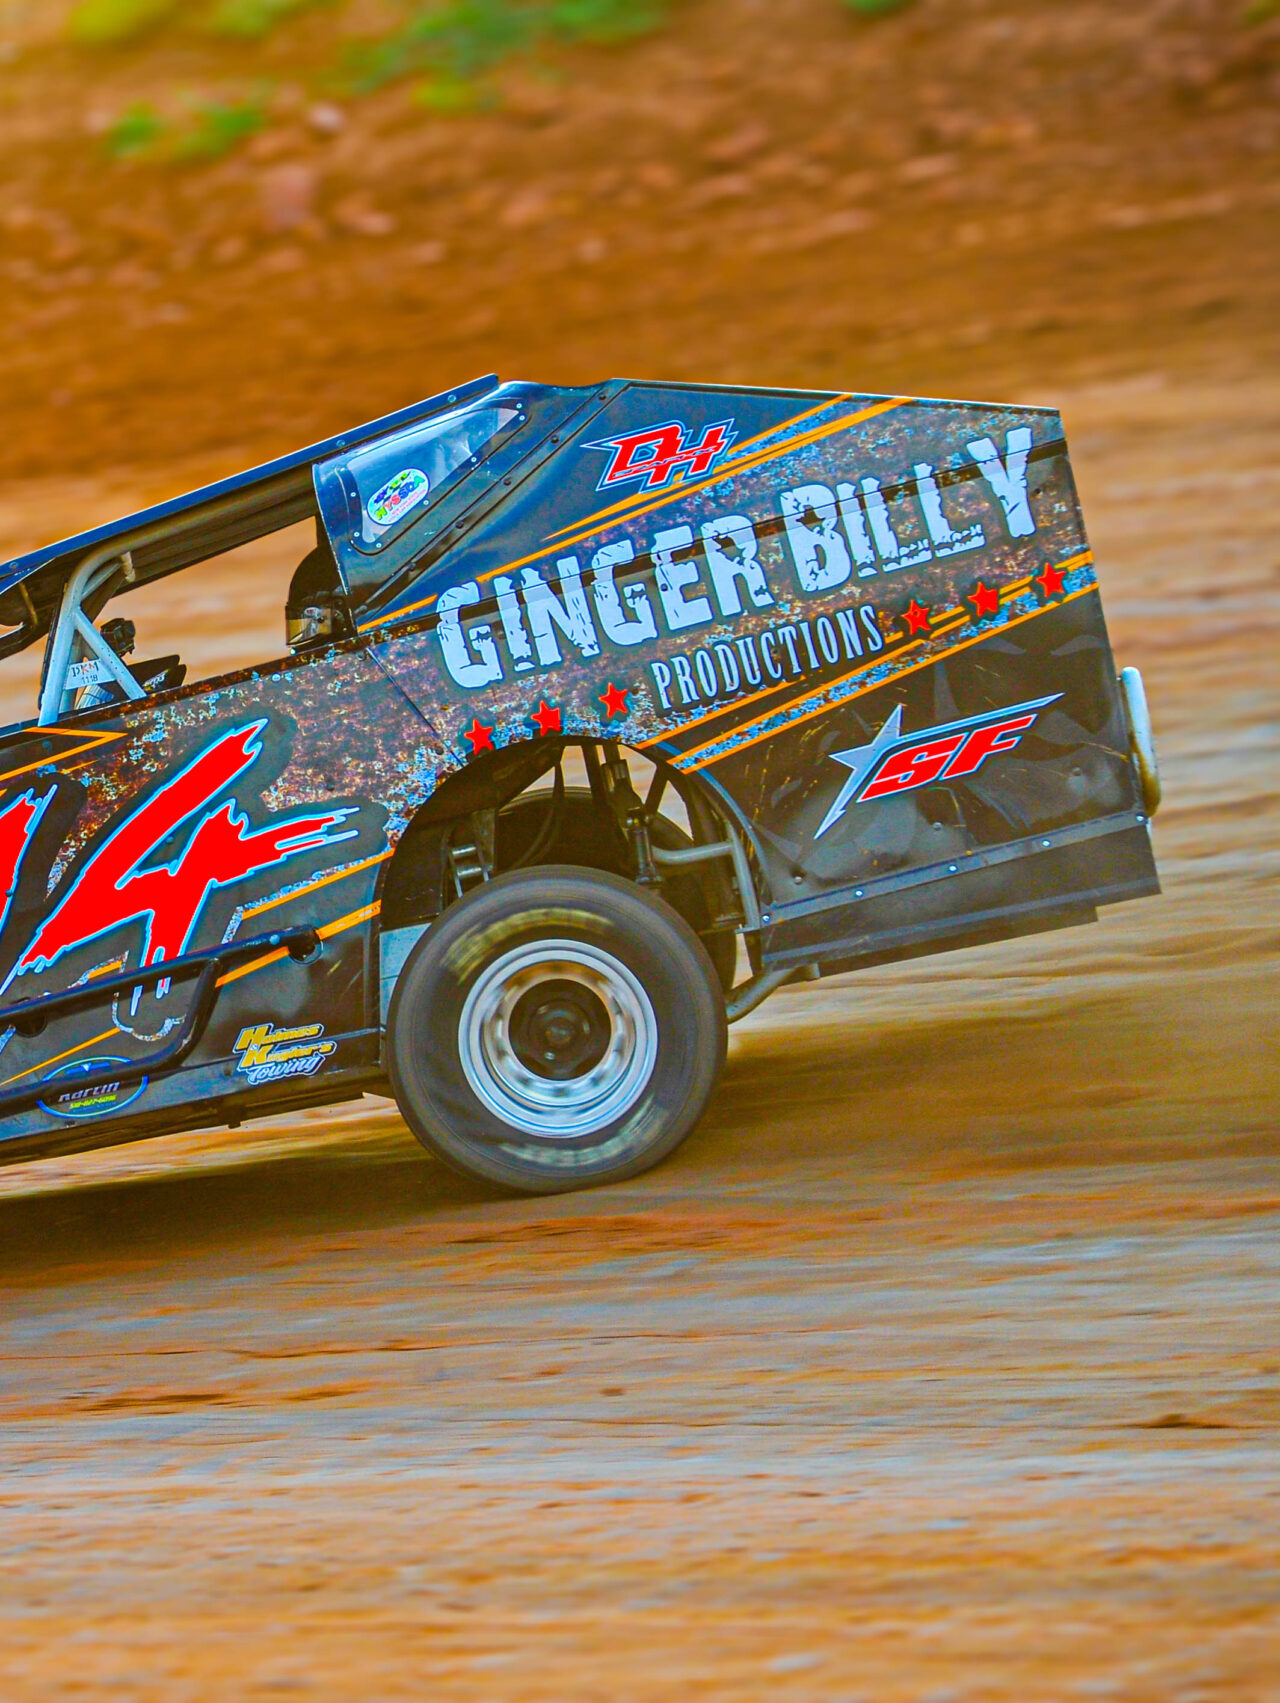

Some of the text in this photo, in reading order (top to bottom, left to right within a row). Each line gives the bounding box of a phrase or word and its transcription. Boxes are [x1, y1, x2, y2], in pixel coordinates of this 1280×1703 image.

[436, 426, 1036, 689] GINGER BILLY
[651, 603, 884, 710] PRODUCTIONS
[246, 1055, 321, 1082] Towing
